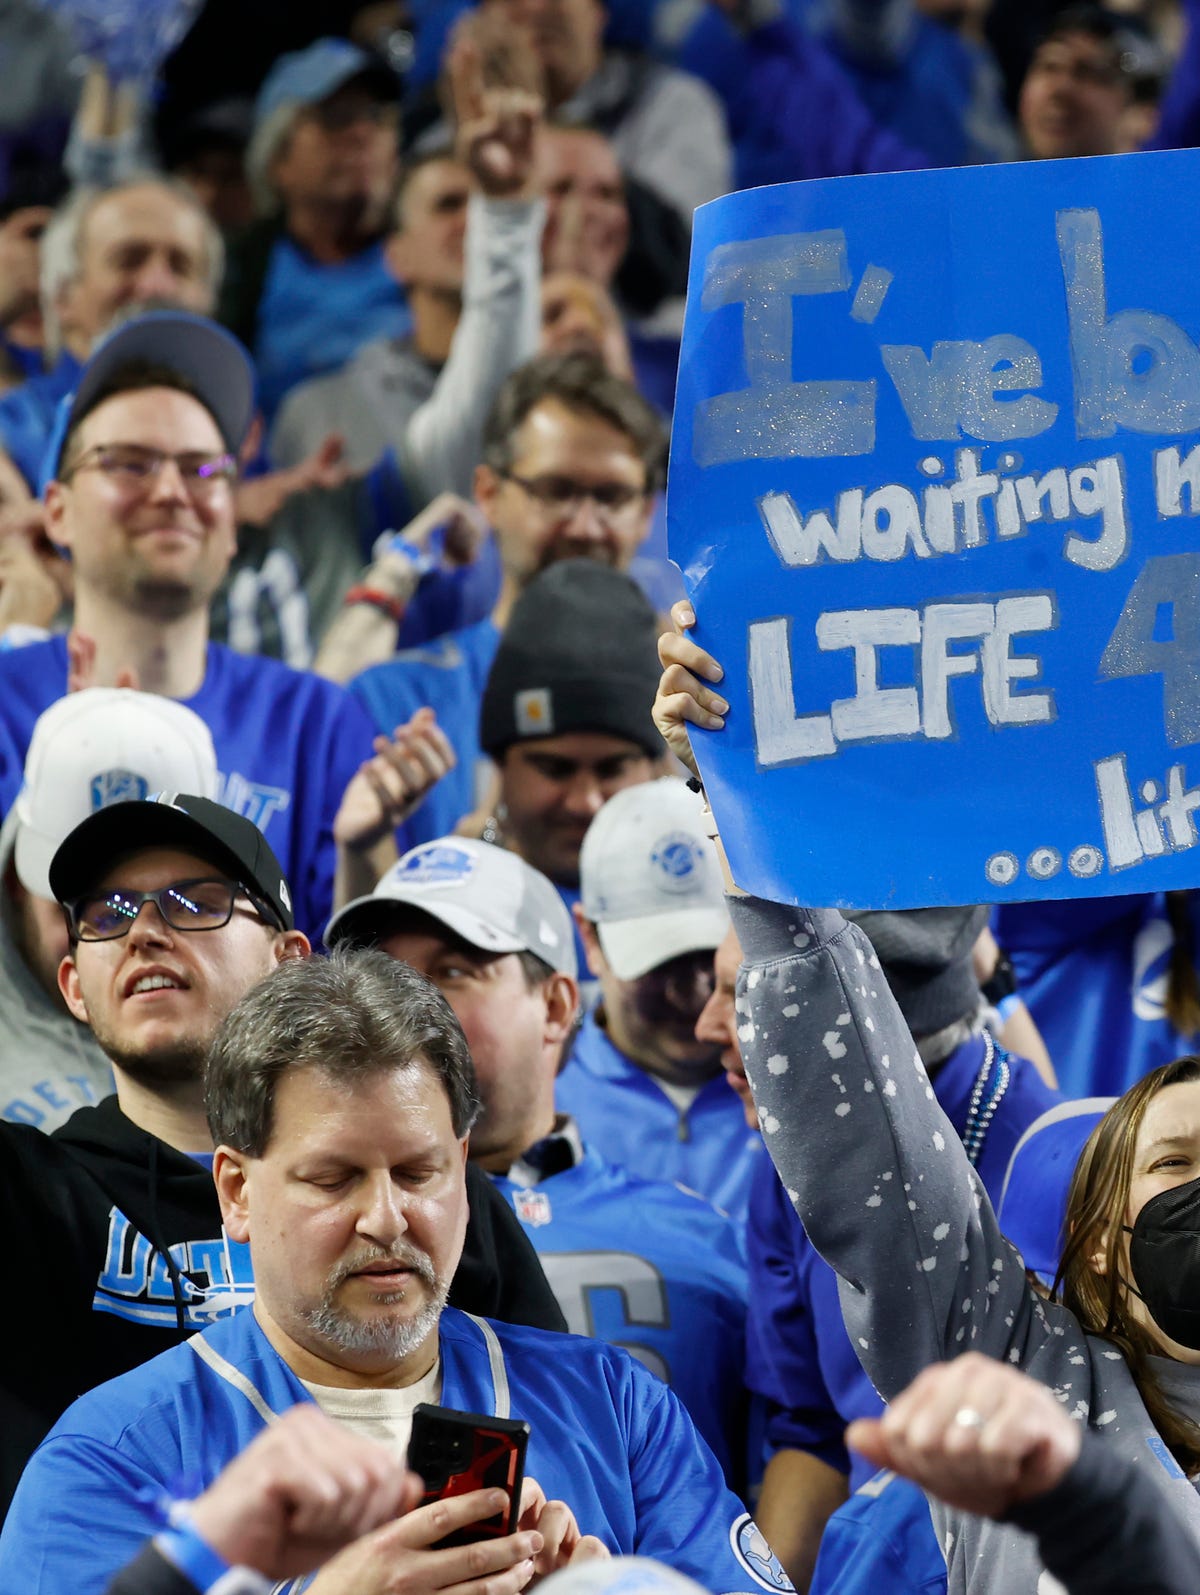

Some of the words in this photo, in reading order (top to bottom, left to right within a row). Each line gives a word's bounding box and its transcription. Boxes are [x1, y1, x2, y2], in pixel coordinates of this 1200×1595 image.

[696, 228, 1058, 467] I've
[760, 447, 1126, 572] waiting
[748, 596, 1057, 767] LIFE
